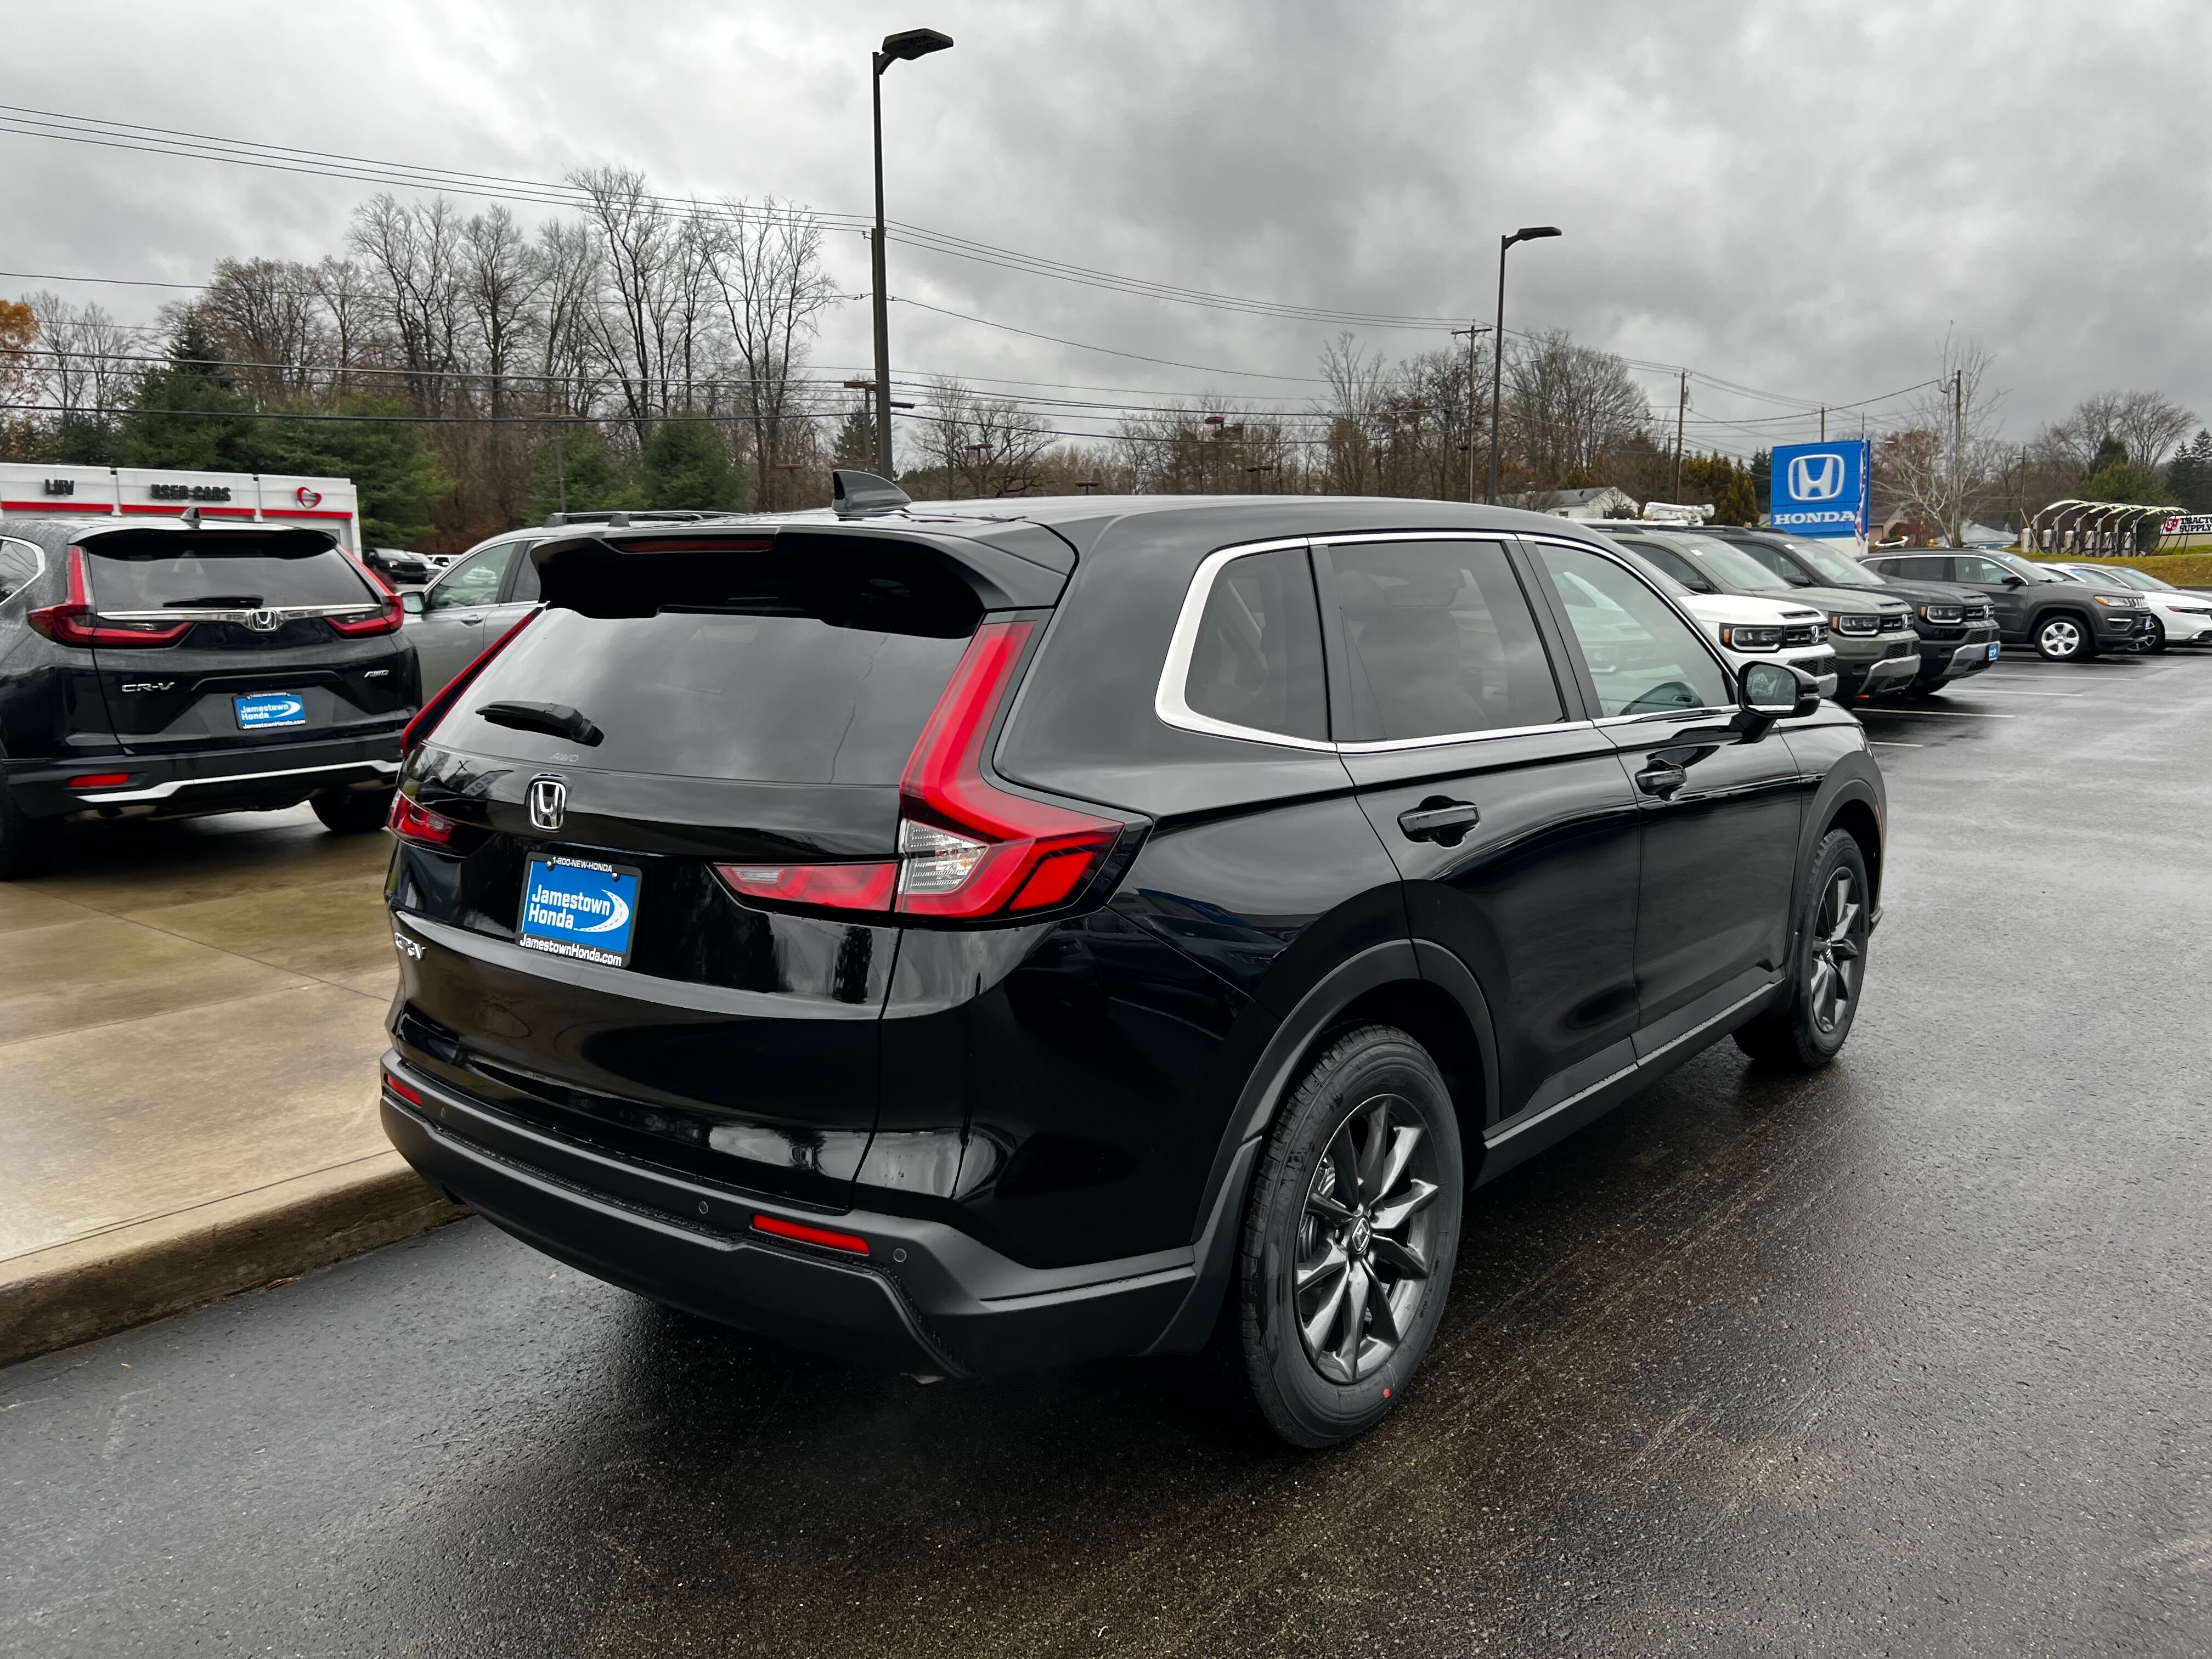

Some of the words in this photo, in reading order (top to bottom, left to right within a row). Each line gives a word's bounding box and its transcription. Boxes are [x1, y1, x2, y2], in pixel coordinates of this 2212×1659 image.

[44, 479, 75, 495] LUV
[150, 484, 189, 500] USED
[194, 486, 232, 501] CARS
[1774, 510, 1855, 525] HONDA
[2179, 524, 2212, 532] SUPPLY
[121, 681, 175, 692] CR-V
[240, 704, 289, 713] Jamestown
[241, 712, 269, 720] Honda
[549, 752, 579, 762] AWD
[552, 856, 613, 873] 1-800-NEW-HONDA
[532, 884, 611, 916] Jamestown
[528, 903, 574, 930] Honda
[520, 933, 622, 967] JamestownHonda.com
